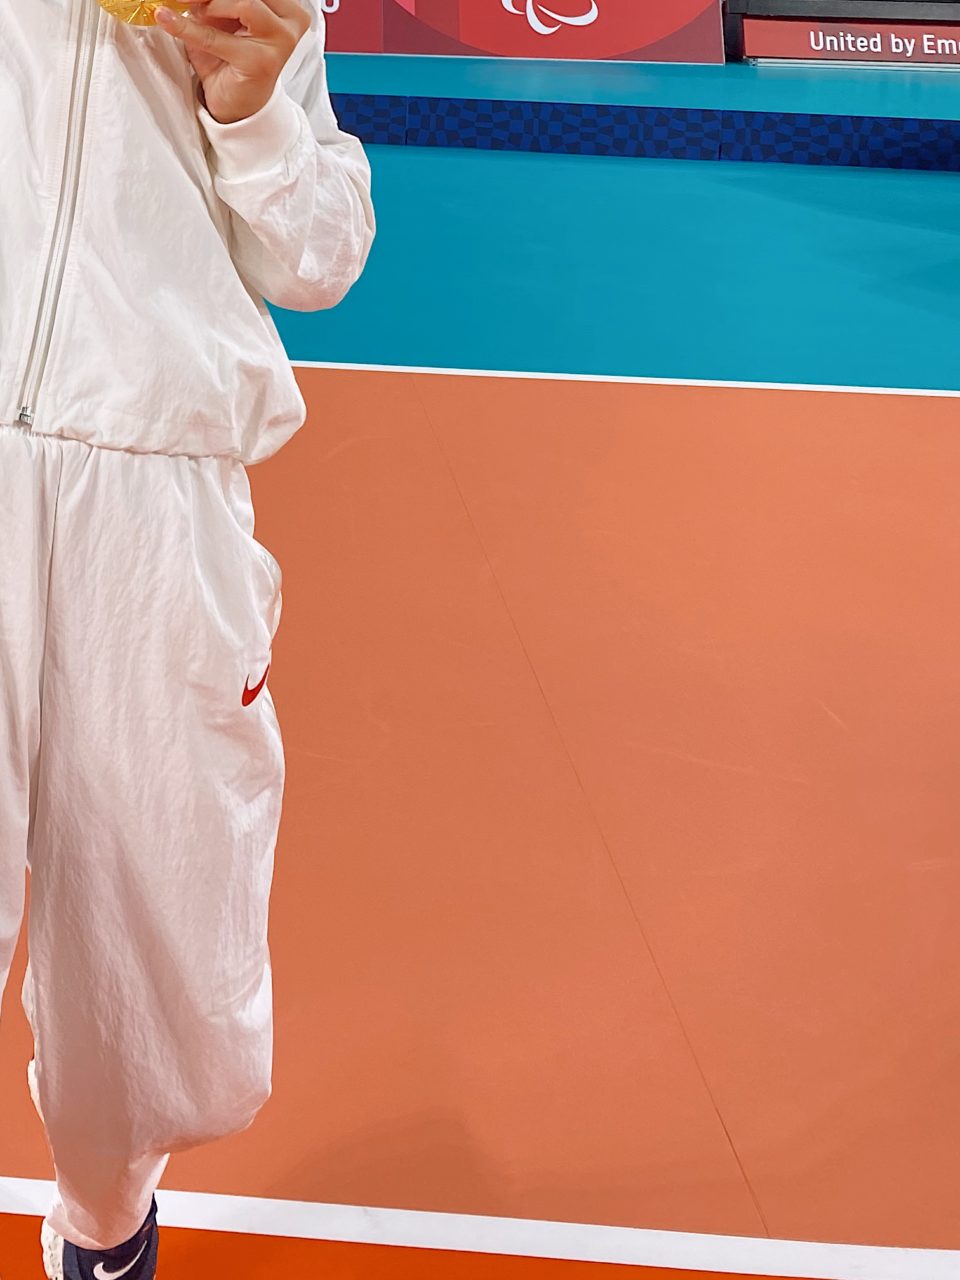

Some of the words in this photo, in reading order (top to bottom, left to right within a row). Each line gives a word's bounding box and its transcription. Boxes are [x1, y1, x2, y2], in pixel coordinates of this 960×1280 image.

[809, 31, 882, 53] United
[891, 33, 916, 57] by
[922, 34, 960, 56] Em
